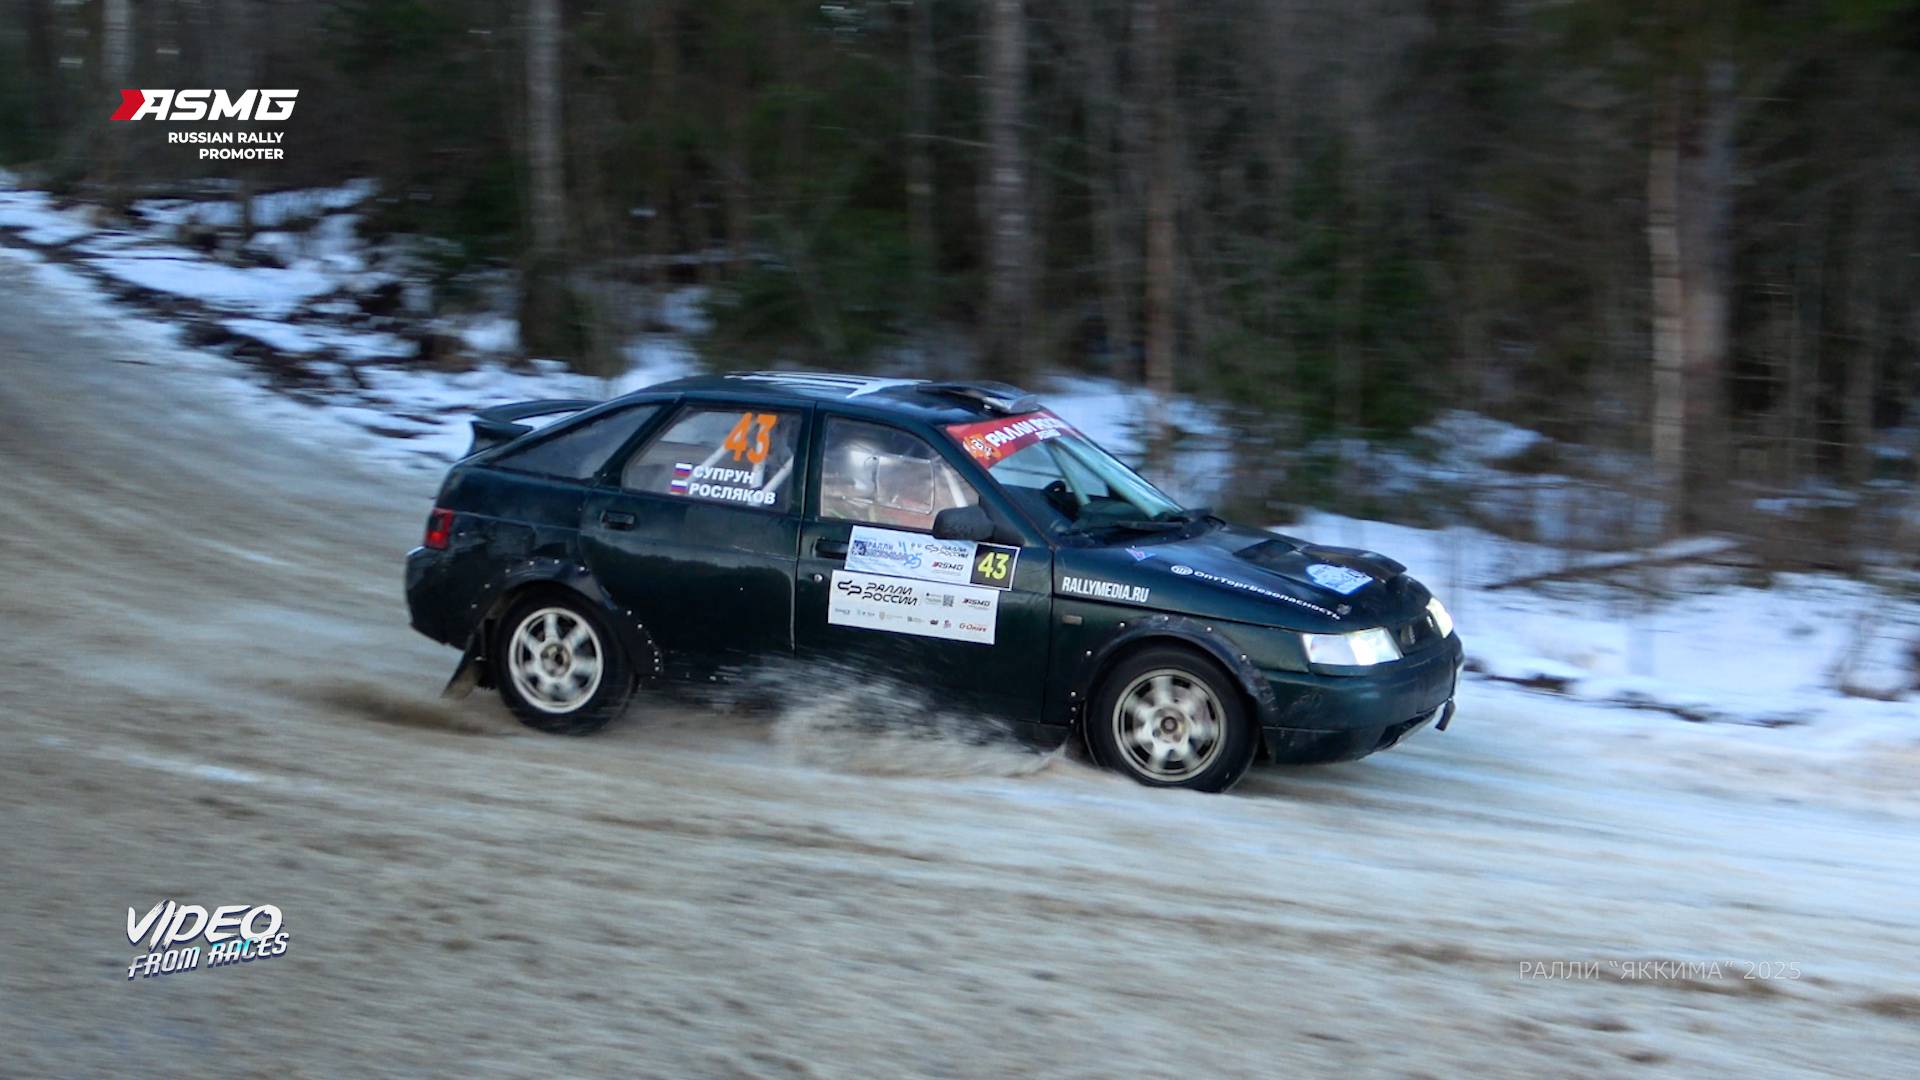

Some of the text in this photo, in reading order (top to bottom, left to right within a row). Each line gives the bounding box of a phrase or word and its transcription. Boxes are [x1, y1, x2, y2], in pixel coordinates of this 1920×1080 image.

[724, 412, 777, 464] 43
[693, 465, 754, 484] СУПРУН
[689, 483, 776, 505] РОСЛЯКОВ
[977, 552, 1010, 580] 43
[862, 591, 918, 606] РОССИИ
[866, 582, 913, 596] РАЛЛИ
[1062, 576, 1149, 603] RALLYMEDIA.RU
